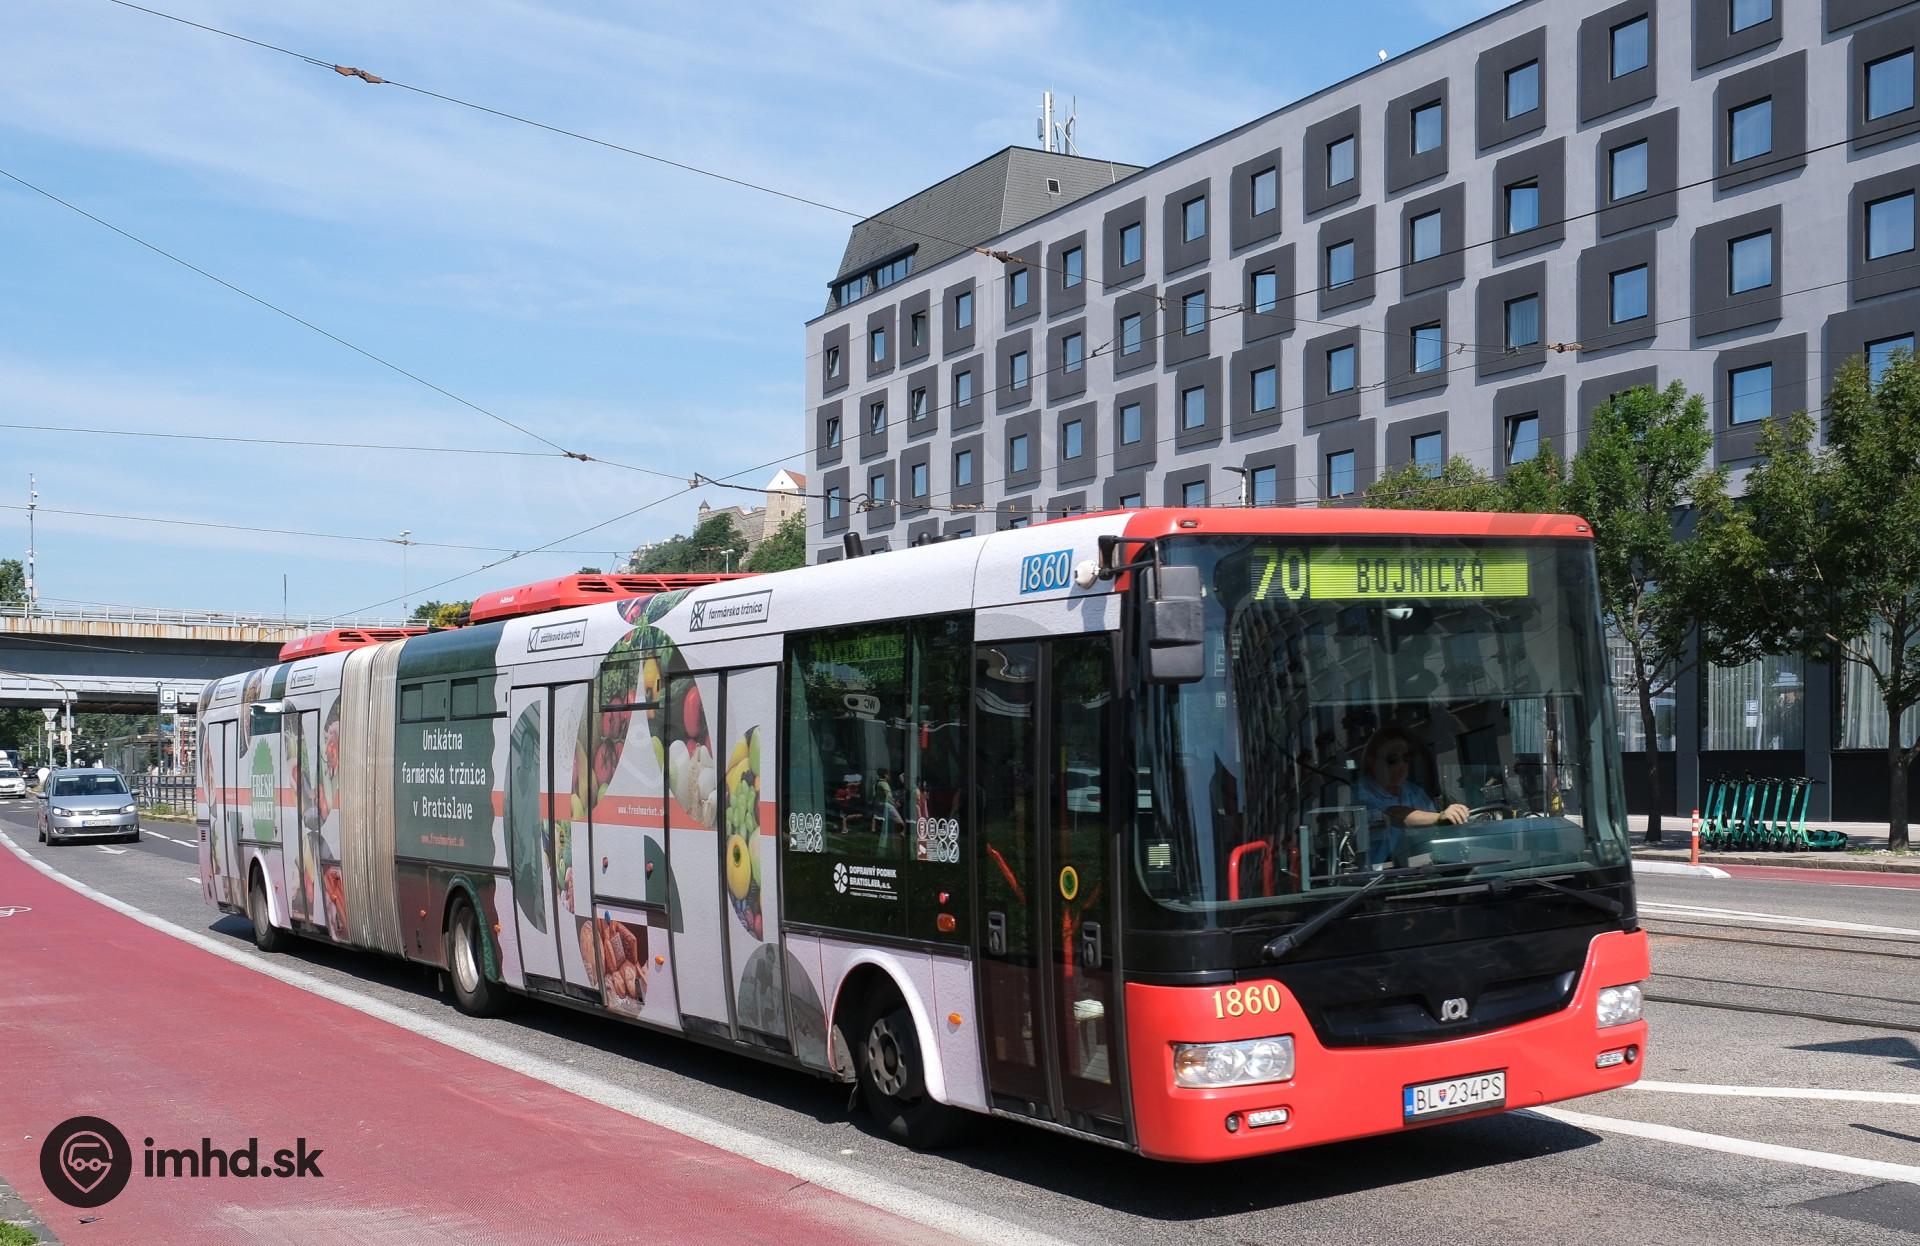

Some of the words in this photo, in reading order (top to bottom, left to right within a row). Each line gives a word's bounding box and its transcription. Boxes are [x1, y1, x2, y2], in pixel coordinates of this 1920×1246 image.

[1021, 551, 1071, 591] 1860
[1253, 548, 1307, 600] 70
[1356, 551, 1485, 594] BOJNICKÁ
[422, 728, 464, 751] Unikátna
[401, 762, 445, 785] farmárska
[449, 761, 487, 785] tržnica
[252, 773, 274, 798] FRESH
[412, 800, 419, 817] v
[422, 796, 474, 820] Bratislave
[876, 867, 897, 878] PODNIK
[1212, 983, 1281, 1020] 1860
